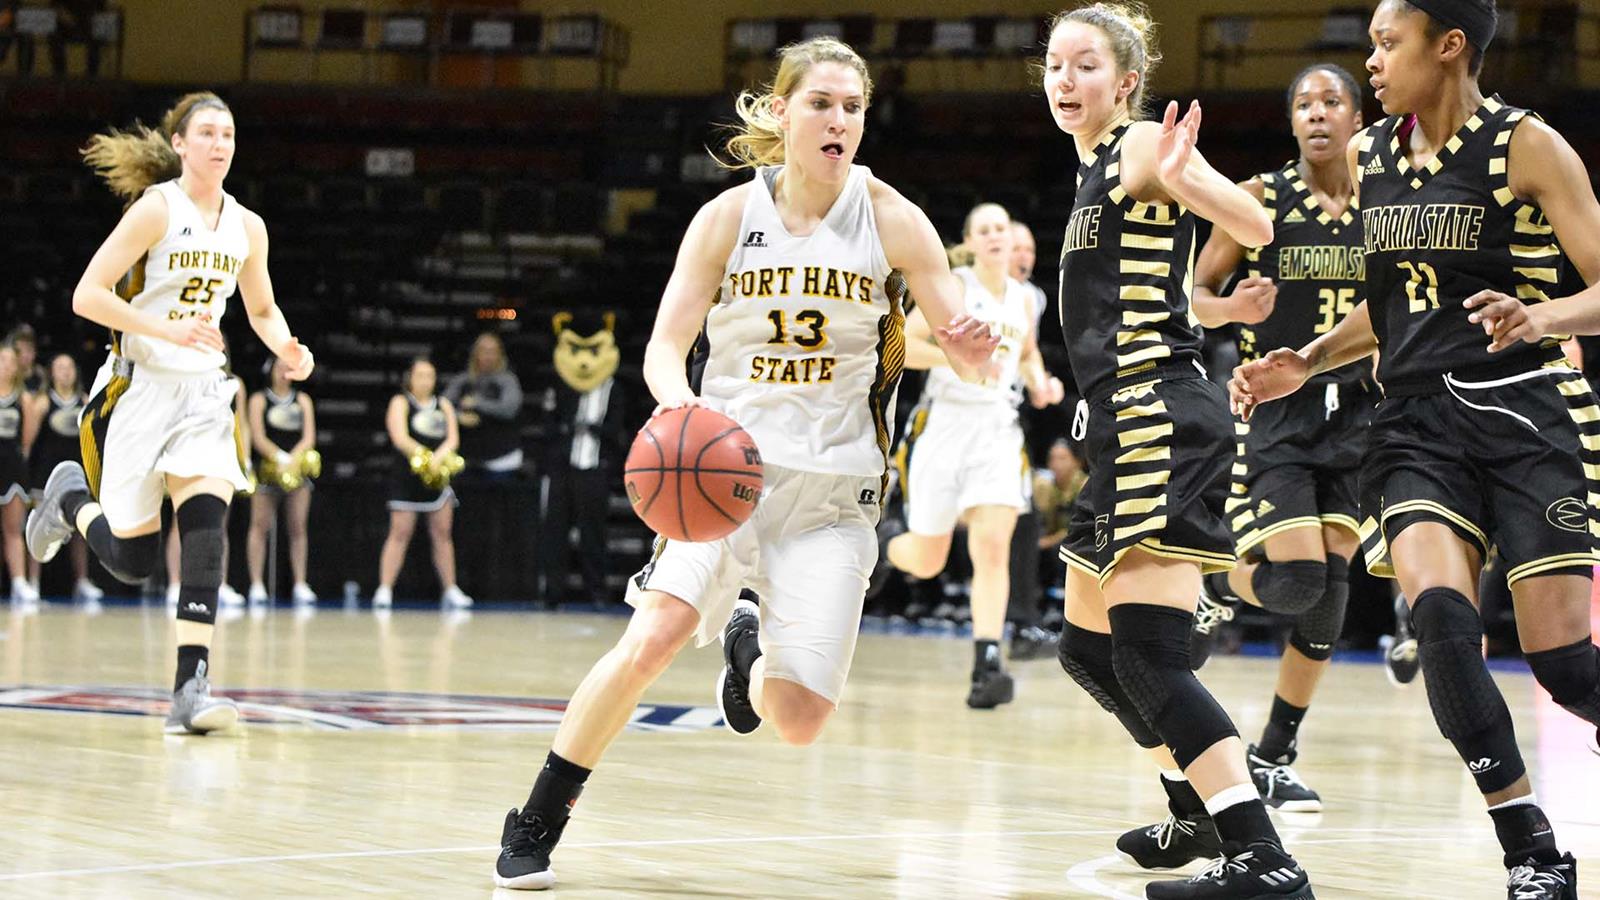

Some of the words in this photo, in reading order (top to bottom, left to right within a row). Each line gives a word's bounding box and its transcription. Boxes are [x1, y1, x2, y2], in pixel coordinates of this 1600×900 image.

[1364, 166, 1385, 175] adidas
[1417, 204, 1484, 250] STATE
[168, 251, 209, 272] FORT
[212, 252, 242, 275] HAY
[1279, 246, 1346, 280] EMPORIA
[179, 277, 226, 306] 25
[803, 267, 875, 305] HAYS
[1396, 261, 1440, 314] 21
[1314, 288, 1355, 334] 35
[767, 309, 829, 352] 13
[749, 355, 837, 384] STATE
